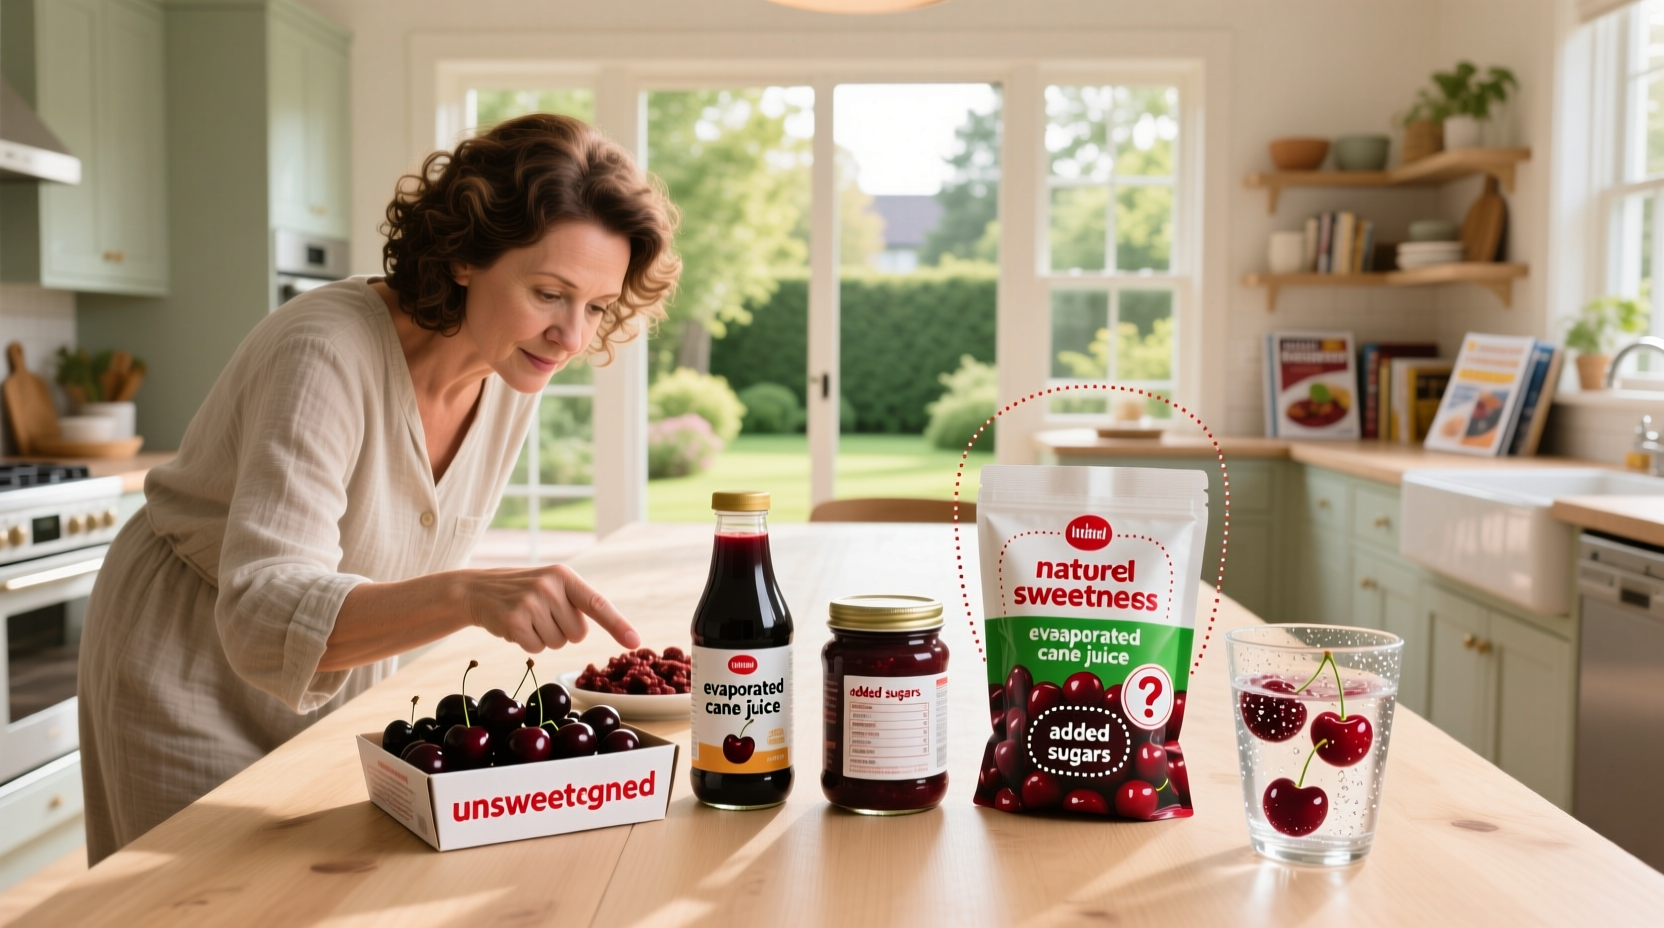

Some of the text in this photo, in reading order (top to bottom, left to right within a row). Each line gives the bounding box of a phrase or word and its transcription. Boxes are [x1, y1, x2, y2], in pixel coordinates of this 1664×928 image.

[1036, 559, 1135, 582] naturel
[1014, 585, 1158, 611] sweetness
[1038, 645, 1130, 668] cane juice
[704, 678, 784, 700] evaporated
[849, 686, 921, 701] added sugars
[1138, 676, 1163, 718] ?
[705, 699, 781, 720] cane juice
[1049, 722, 1110, 742] added
[1048, 747, 1110, 766] sugars
